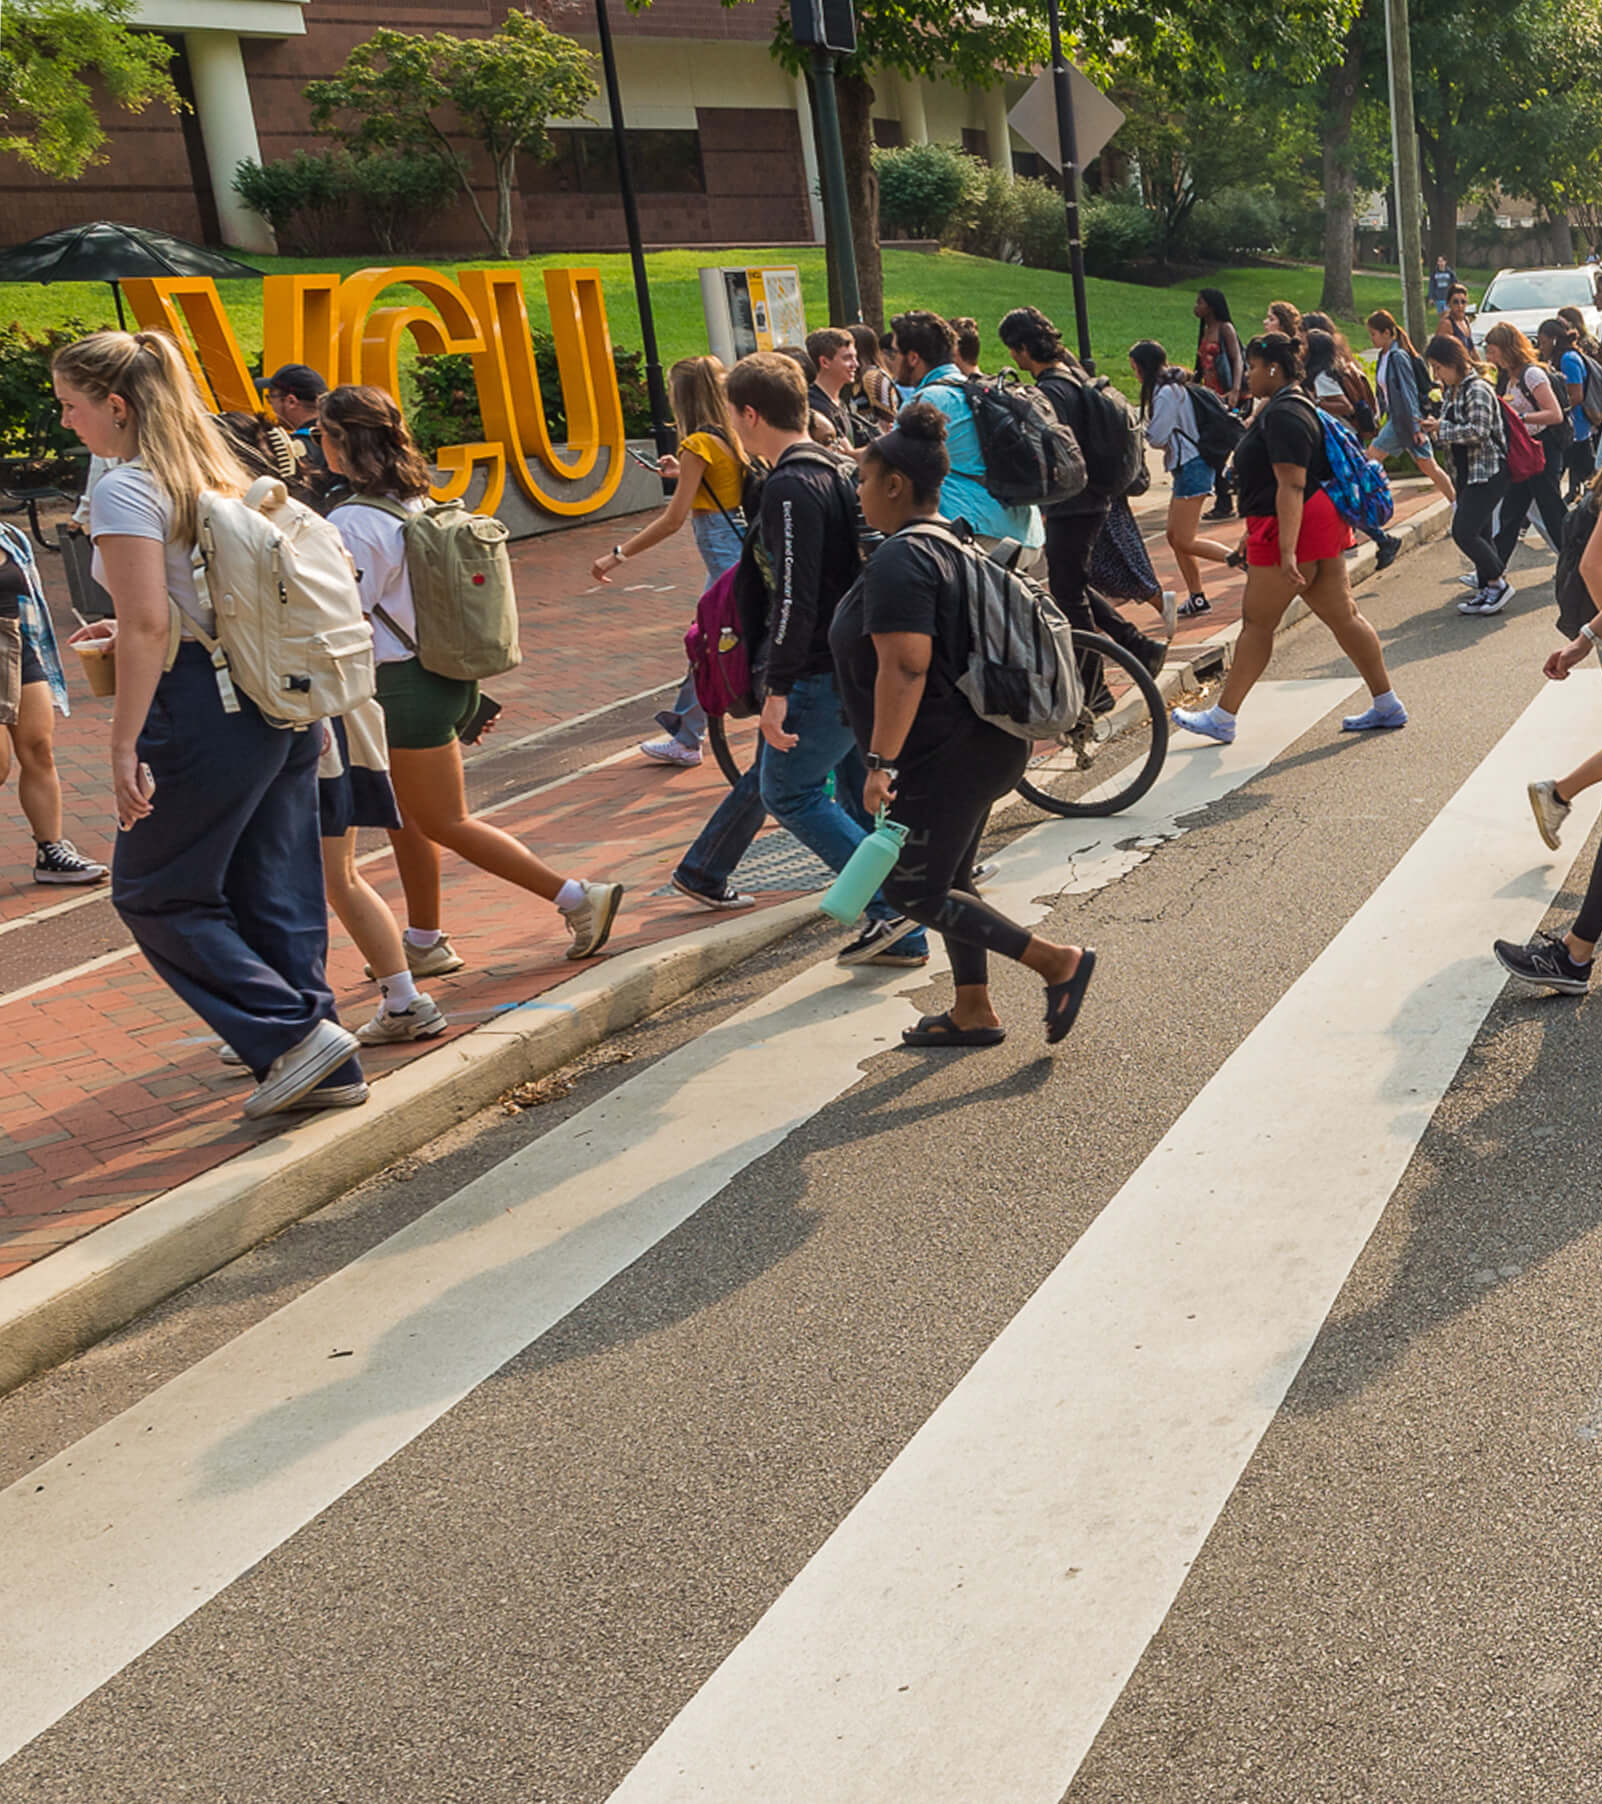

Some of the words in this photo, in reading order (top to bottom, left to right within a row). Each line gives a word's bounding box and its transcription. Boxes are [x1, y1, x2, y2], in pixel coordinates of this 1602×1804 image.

[119, 266, 625, 516] VCU
[783, 500, 794, 538] Electrical
[785, 540, 794, 556] and
[784, 557, 794, 598] Computer
[774, 599, 793, 645] Engineering
